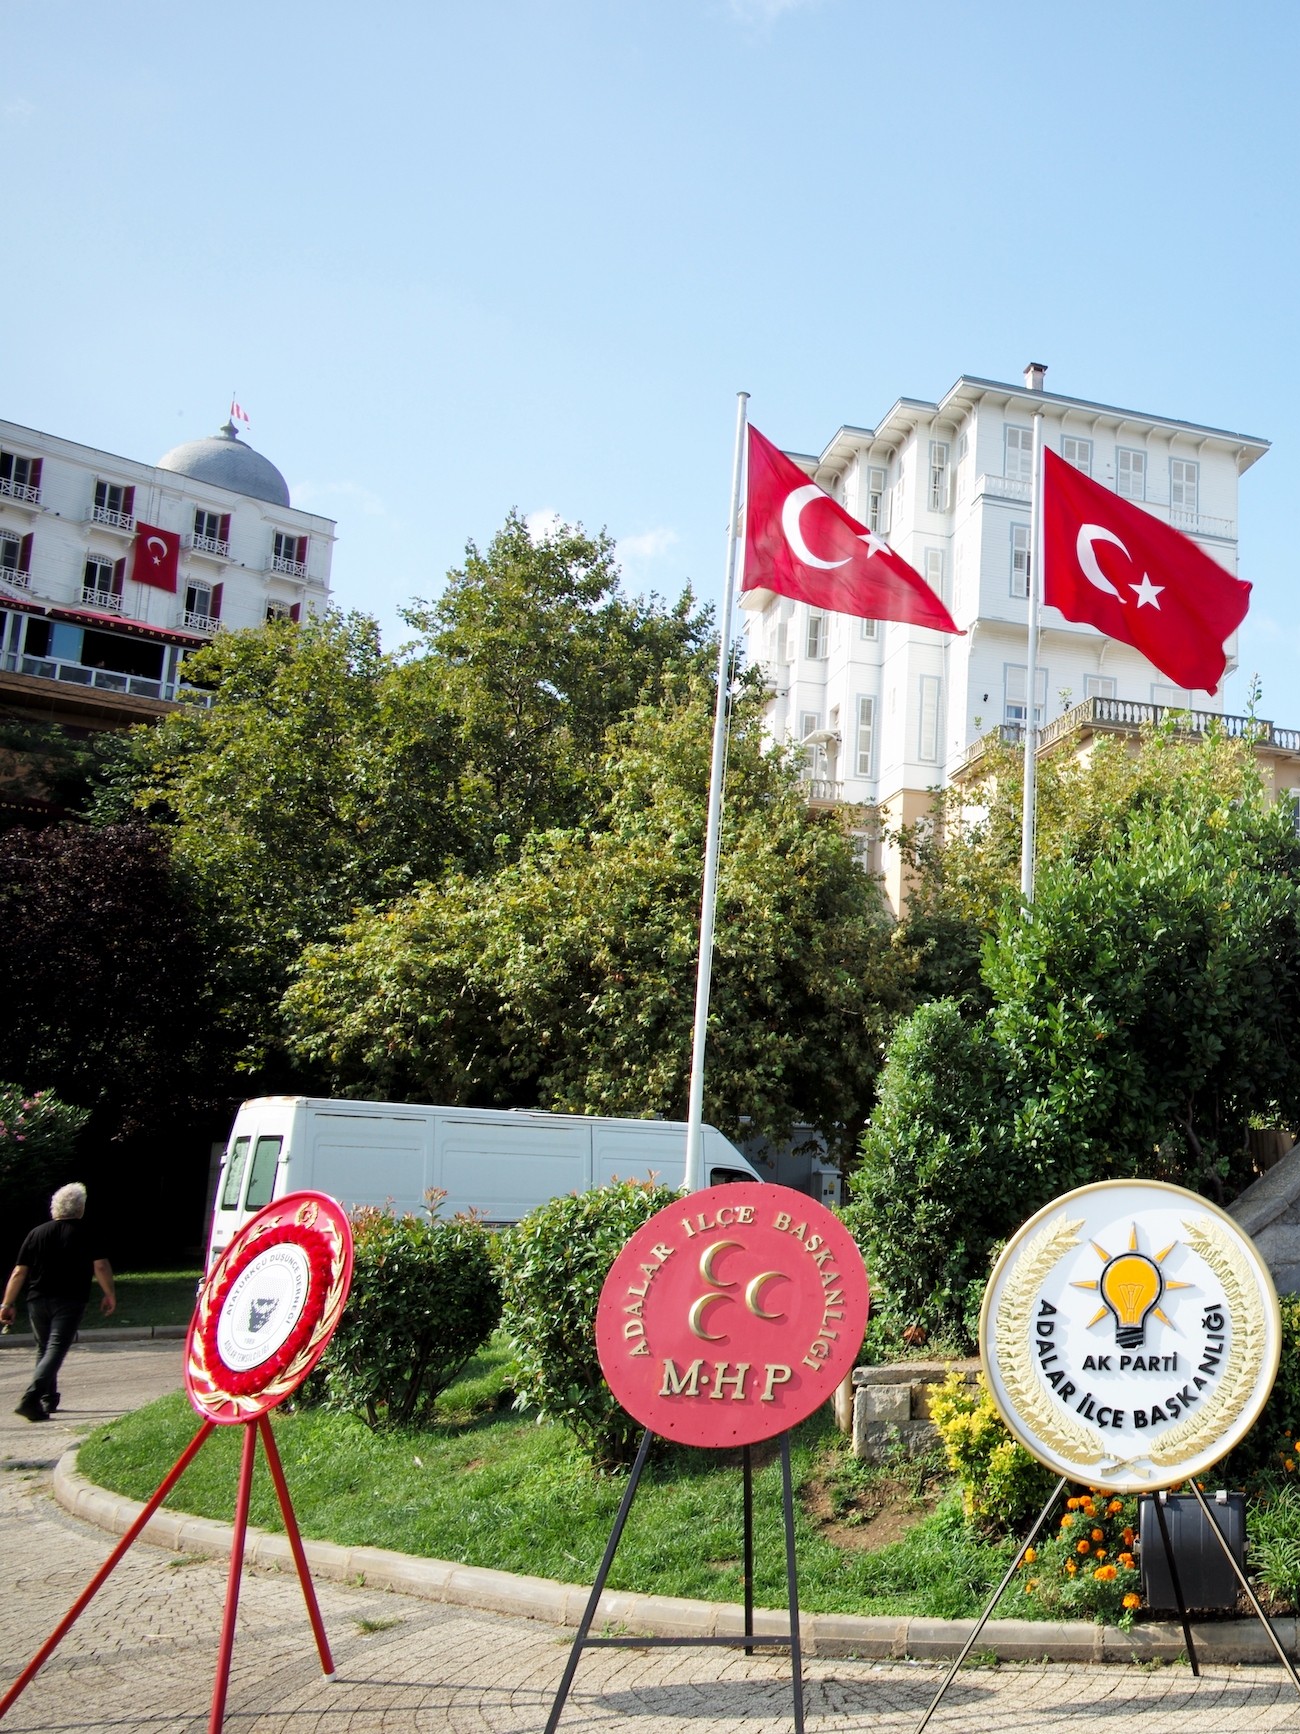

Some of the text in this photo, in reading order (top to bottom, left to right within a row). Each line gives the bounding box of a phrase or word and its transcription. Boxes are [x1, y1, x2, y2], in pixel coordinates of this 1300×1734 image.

[623, 1242, 675, 1357] ADALAR
[682, 1206, 756, 1237] İLÇE
[1036, 1299, 1225, 1429] ADALAR İLÇE BAŞKANLIĞI
[1083, 1352, 1178, 1372] AK PARTİ
